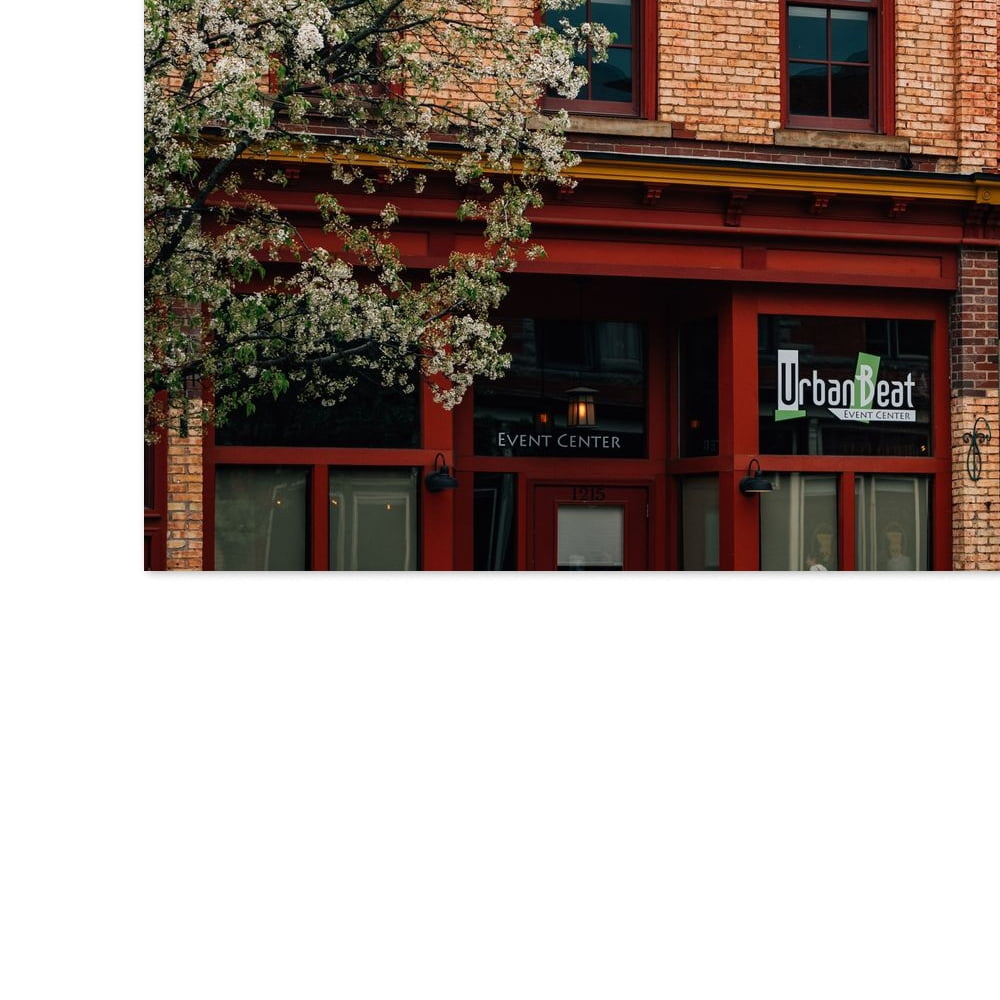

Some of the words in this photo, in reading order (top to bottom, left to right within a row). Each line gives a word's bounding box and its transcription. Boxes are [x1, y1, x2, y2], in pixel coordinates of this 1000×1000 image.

[777, 349, 916, 408] UrbanBeat
[843, 409, 873, 419] EVENT
[875, 410, 911, 420] CENTER
[498, 432, 552, 447] EVENT
[557, 433, 621, 449] CENTER
[571, 487, 606, 501] 1215
